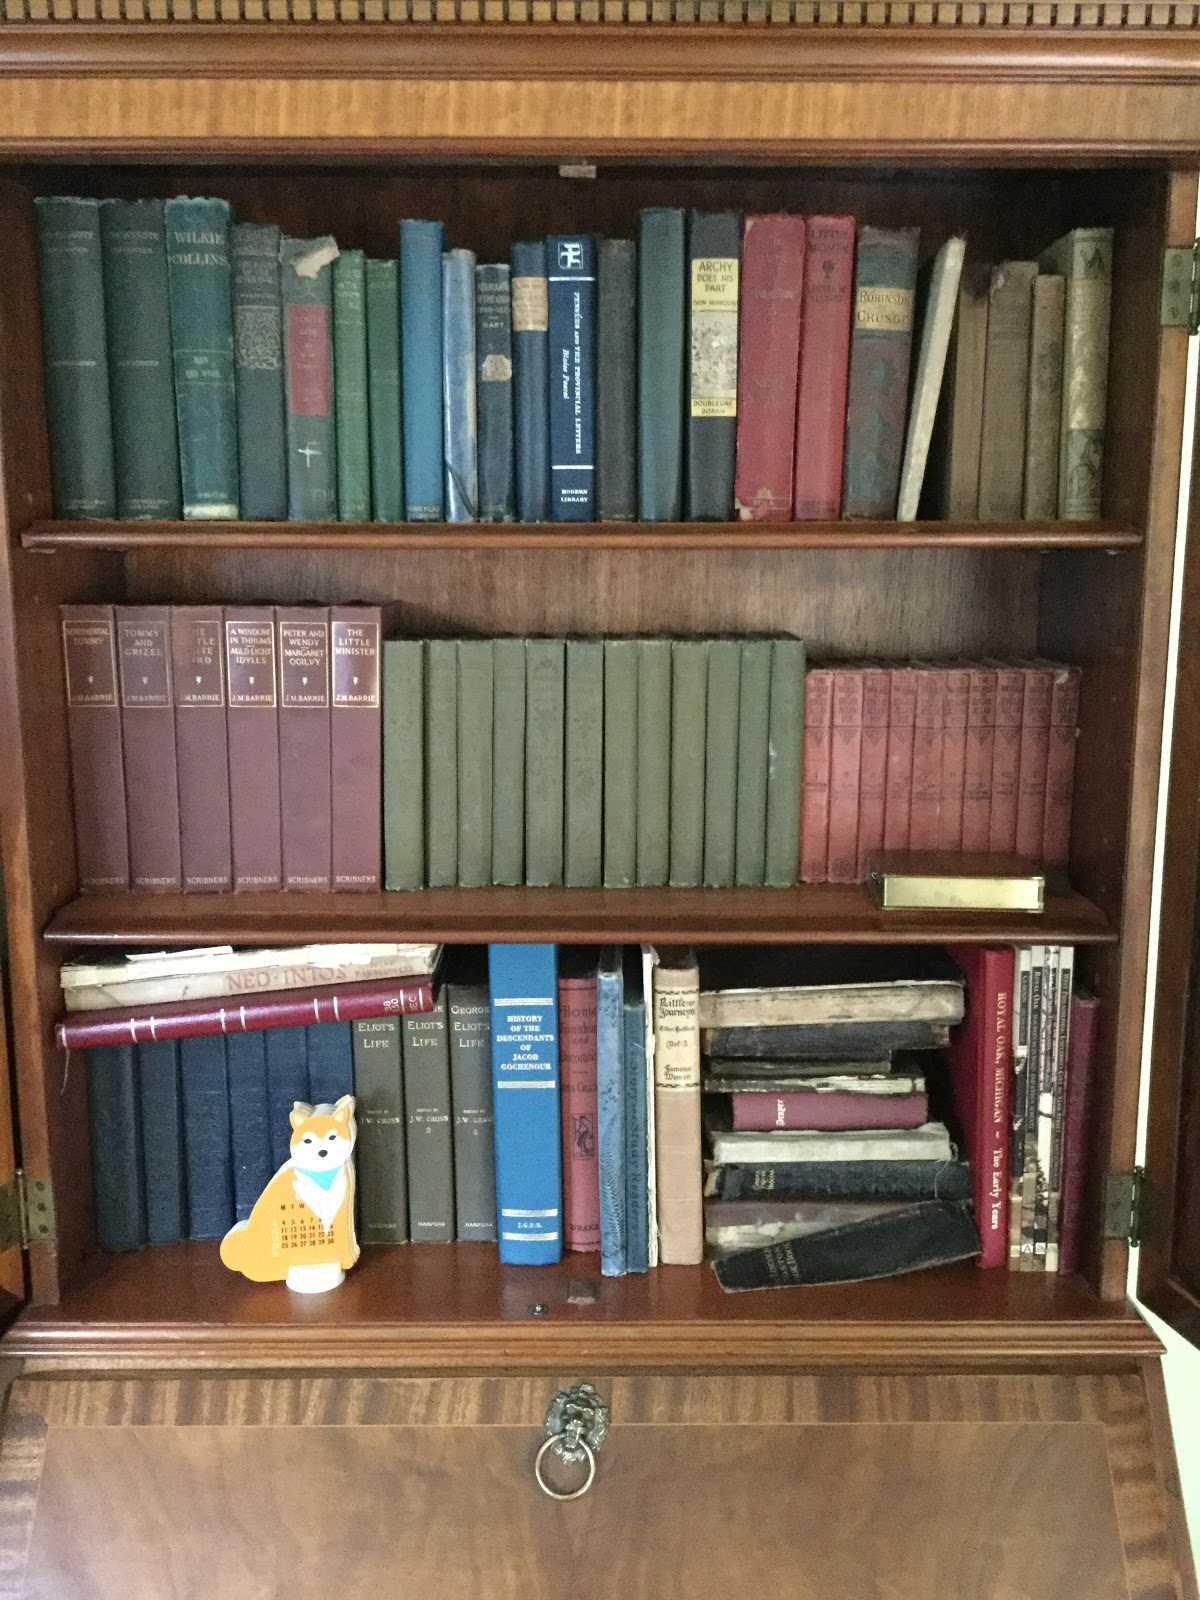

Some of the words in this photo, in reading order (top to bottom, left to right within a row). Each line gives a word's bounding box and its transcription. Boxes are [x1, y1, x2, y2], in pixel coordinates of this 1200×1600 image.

[174, 231, 225, 245] WILKIE
[170, 252, 228, 266] COLLINS
[699, 261, 733, 272] ARCHY
[697, 273, 717, 282] DOES
[721, 274, 734, 282] HIS
[705, 284, 726, 293] PART
[860, 290, 911, 306] ROBINSON
[124, 629, 160, 637] TOMMY
[238, 628, 270, 636] WINDOW
[283, 629, 307, 638] PETER
[309, 630, 325, 638] AND
[347, 628, 364, 636] THE
[134, 639, 154, 647] AND
[241, 637, 272, 645] THRUMS
[289, 638, 319, 646] WENDY
[339, 638, 371, 646] LITTLE
[125, 648, 163, 656] GRIZEL
[230, 647, 250, 655] AULD
[285, 649, 324, 657] MARGARET
[335, 647, 375, 656] MINISTER
[236, 656, 267, 664] IDYLLS
[289, 658, 321, 666] OGILVY
[187, 876, 228, 884] SCRIBNERS
[237, 876, 278, 884] SCRIBNERS
[287, 876, 328, 884] SCRIBNERS
[336, 875, 376, 883] SCRIBNERS
[1033, 971, 1041, 993] ROYAL
[383, 1000, 392, 1012] 38
[1032, 994, 1040, 1010] OAK
[450, 1005, 490, 1015] GEORGE
[659, 1008, 696, 1019] Journeys
[996, 992, 1007, 1033] ROYAL
[358, 1022, 395, 1032] ELIOT'S
[407, 1020, 444, 1030] ELIOT'S
[453, 1021, 490, 1031] ELIOT'S
[523, 1024, 540, 1032] THE
[412, 1037, 439, 1047] LIFE
[496, 1034, 554, 1042] DESCENDANTS
[363, 1039, 390, 1049] LIFE
[459, 1038, 485, 1048] LIFE
[994, 1035, 1006, 1064] OAK,
[512, 1053, 539, 1061] JACOB
[664, 1064, 692, 1074] Famous
[664, 1072, 691, 1081] Women
[993, 1067, 1004, 1123] MICHIGAN
[775, 1098, 786, 1127] Prayer
[426, 1115, 449, 1123] CROSS
[425, 1126, 432, 1135] 2
[993, 1147, 1003, 1168] The
[989, 1171, 1002, 1198] Early
[991, 1201, 1002, 1230] Years
